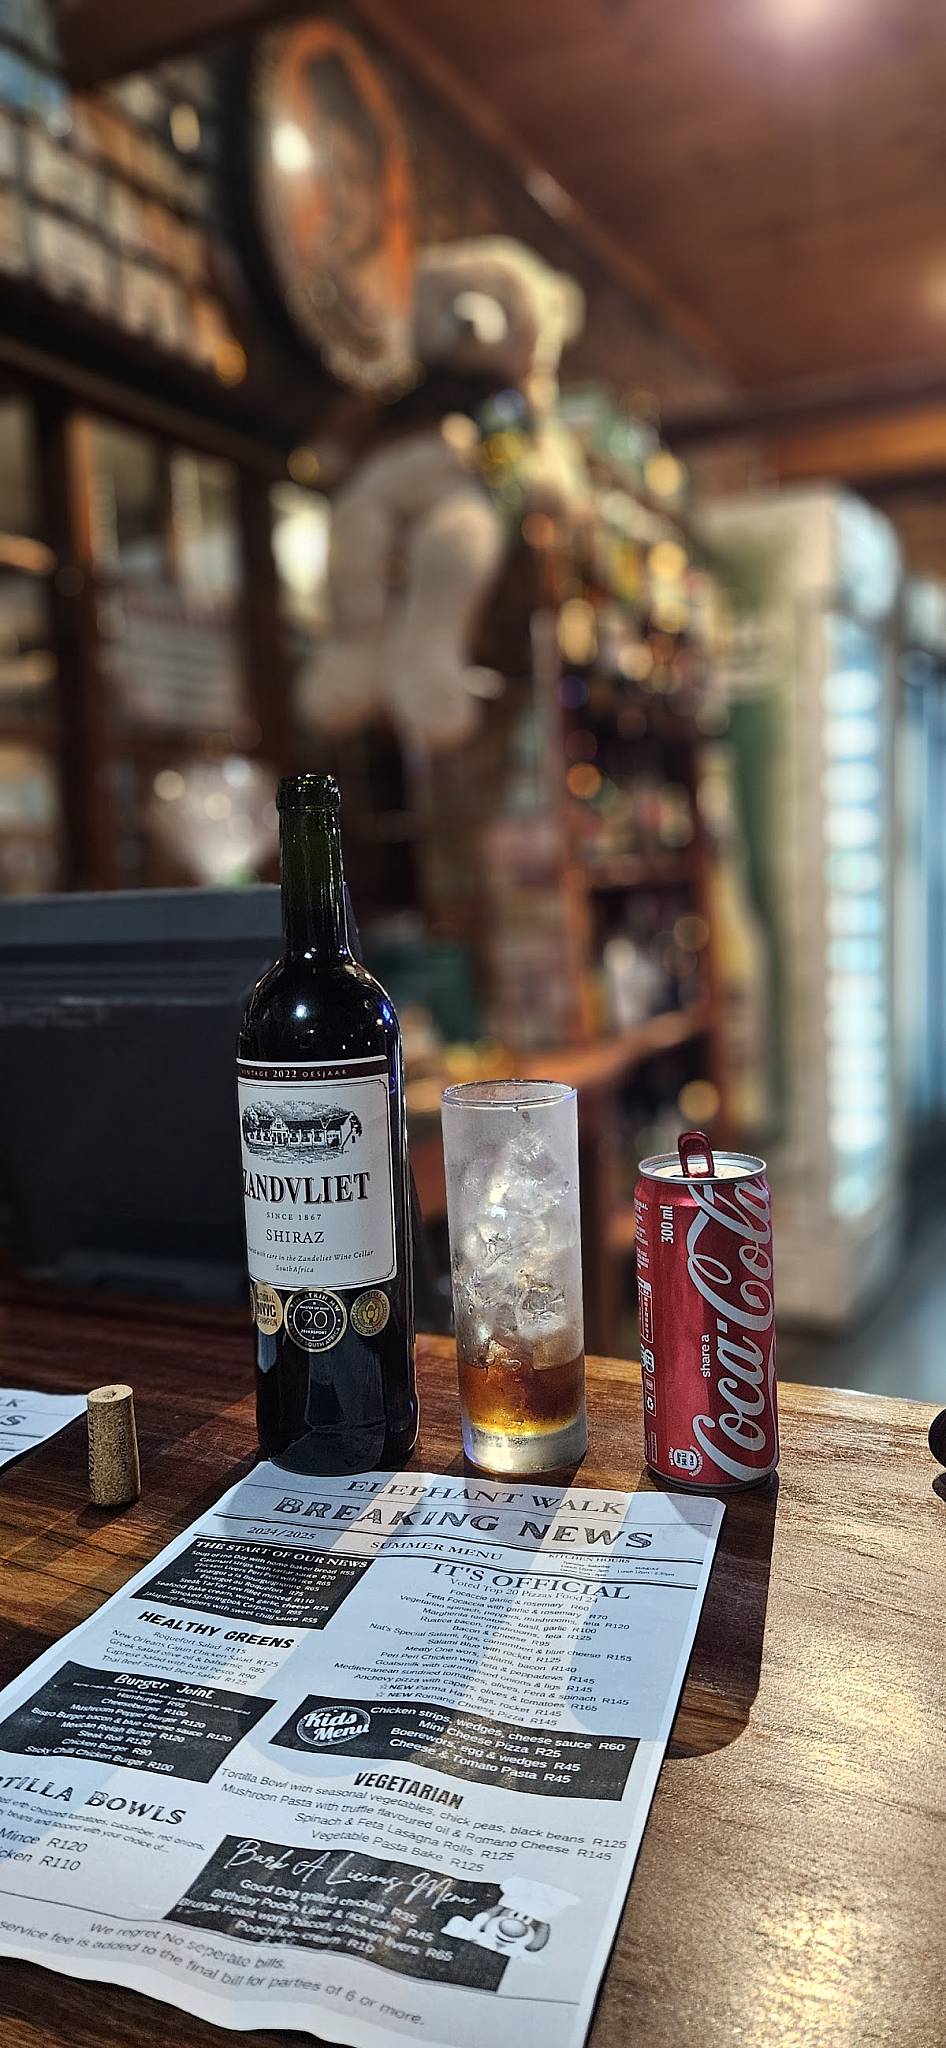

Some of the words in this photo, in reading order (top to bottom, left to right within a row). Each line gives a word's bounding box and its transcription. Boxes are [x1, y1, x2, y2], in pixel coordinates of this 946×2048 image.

[272, 1069, 297, 1078] 2022
[301, 1069, 347, 1079] OESJAAR
[266, 1211, 293, 1221] SINCE
[298, 1213, 322, 1221] 1867
[659, 1205, 674, 1220] ml
[266, 1229, 325, 1244] SHIRAZ
[661, 1221, 674, 1244] 300
[334, 1253, 352, 1262] Wine
[353, 1249, 374, 1260] Cellar
[301, 1309, 328, 1328] 90
[701, 1334, 711, 1342] a
[701, 1346, 711, 1378] share
[344, 1480, 523, 1504] ELEPHANT
[531, 1494, 626, 1516] WALK
[247, 1526, 316, 1540] 2024/2025
[273, 1496, 499, 1531] BREAKING
[518, 1520, 653, 1549] NEWS
[195, 1541, 226, 1550] THE
[226, 1544, 270, 1555] START
[272, 1550, 293, 1558] OF
[293, 1553, 325, 1564] OUR
[326, 1558, 368, 1568] NEWS
[370, 1541, 444, 1554] SUMMER
[447, 1546, 503, 1561] MENU
[431, 1562, 485, 1582] IT'S
[492, 1574, 630, 1600] OFFICIAL
[450, 1578, 480, 1590] Voted
[482, 1584, 504, 1596] Top
[505, 1588, 519, 1596] 20
[521, 1590, 552, 1599] Pizzas
[555, 1592, 583, 1602] Food
[137, 1611, 222, 1637] HEALTHY
[223, 1631, 295, 1649] GREENS
[153, 1631, 196, 1646] Roquefort
[197, 1641, 222, 1650] Salad
[452, 1625, 480, 1634] Bacon
[491, 1630, 527, 1642] Cheese
[112, 1629, 134, 1639] New
[133, 1635, 165, 1648] Orleans
[167, 1643, 192, 1654] Cajun
[193, 1648, 228, 1659] Chicken
[228, 1654, 253, 1663] Salad
[113, 1673, 170, 1690] Burger
[176, 1684, 216, 1699] Joint
[180, 1719, 206, 1729] R120
[304, 1709, 358, 1728] Kids
[313, 1722, 370, 1741] Menu
[370, 1706, 417, 1716] Chicken
[418, 1709, 453, 1724] strips,
[456, 1718, 505, 1739] wedges,
[508, 1731, 553, 1745] cheese
[555, 1739, 593, 1750] sauce
[598, 1741, 626, 1752] R60
[390, 1727, 457, 1750] Boerewors,
[461, 1744, 483, 1758] egg
[485, 1750, 497, 1760] &
[500, 1755, 548, 1769] wedges
[553, 1761, 581, 1773] R45
[418, 1720, 444, 1733] Mini
[446, 1727, 493, 1746] Cheese
[494, 1741, 529, 1754] Pizza
[534, 1747, 562, 1758] R25
[389, 1738, 436, 1756] Cheese
[438, 1751, 450, 1760] &
[452, 1754, 499, 1773] Tomato
[500, 1766, 538, 1780] Pasta
[543, 1773, 572, 1784] R45
[0, 1776, 74, 1802] TILLA
[84, 1790, 187, 1825] BOWLS
[353, 1772, 465, 1810] VEGETARIAN
[221, 1767, 258, 1784] Tortilla
[259, 1776, 288, 1789] Bowl
[290, 1783, 314, 1793] with
[314, 1787, 368, 1800] seasonal
[369, 1792, 436, 1816] vegetables,
[439, 1811, 471, 1827] chick
[472, 1820, 507, 1834] peas,
[509, 1826, 544, 1838] black
[546, 1831, 585, 1845] beans
[592, 1838, 628, 1850] R125
[0, 1827, 41, 1846] Mince
[46, 1837, 88, 1853] R120
[280, 1794, 313, 1808] Pasta
[315, 1801, 340, 1812] with
[340, 1804, 374, 1815] truffle
[376, 1807, 434, 1829] flavoured
[435, 1825, 450, 1836] oil
[451, 1829, 463, 1838] &
[465, 1831, 518, 1848] Romano
[520, 1840, 570, 1855] Cheese
[577, 1848, 613, 1861] R145
[294, 1812, 343, 1826] Spinach
[344, 1817, 354, 1826] &
[357, 1817, 385, 1831] Feta
[387, 1823, 439, 1847] Lasagna
[442, 1840, 474, 1856] Rolls
[480, 1850, 515, 1862] R125
[0, 1847, 33, 1864] cken
[38, 1855, 81, 1872] R110
[311, 1829, 370, 1843] Vegetable
[372, 1836, 408, 1853] Pasta
[410, 1845, 444, 1862] Bake
[449, 1858, 485, 1873] R125
[223, 1839, 295, 1871] Bark
[291, 1851, 331, 1882] A
[325, 1852, 403, 1893] Licious
[403, 1872, 478, 1910] Menu
[90, 1922, 115, 1935] We
[116, 1926, 160, 1940] regret
[162, 1932, 185, 1946] No
[0, 1920, 48, 1940] service
[51, 1932, 75, 1945] fee
[77, 1937, 90, 1948] is
[92, 1940, 141, 1953] added
[141, 1945, 157, 1956] to
[159, 1949, 184, 1966] the
[186, 1959, 220, 1981] final
[220, 1971, 246, 1986] bill
[246, 1975, 265, 1986] for
[266, 1977, 321, 1993] parties
[325, 1984, 345, 1997] of
[345, 1989, 358, 2002] 6
[379, 2002, 425, 2026] more.
